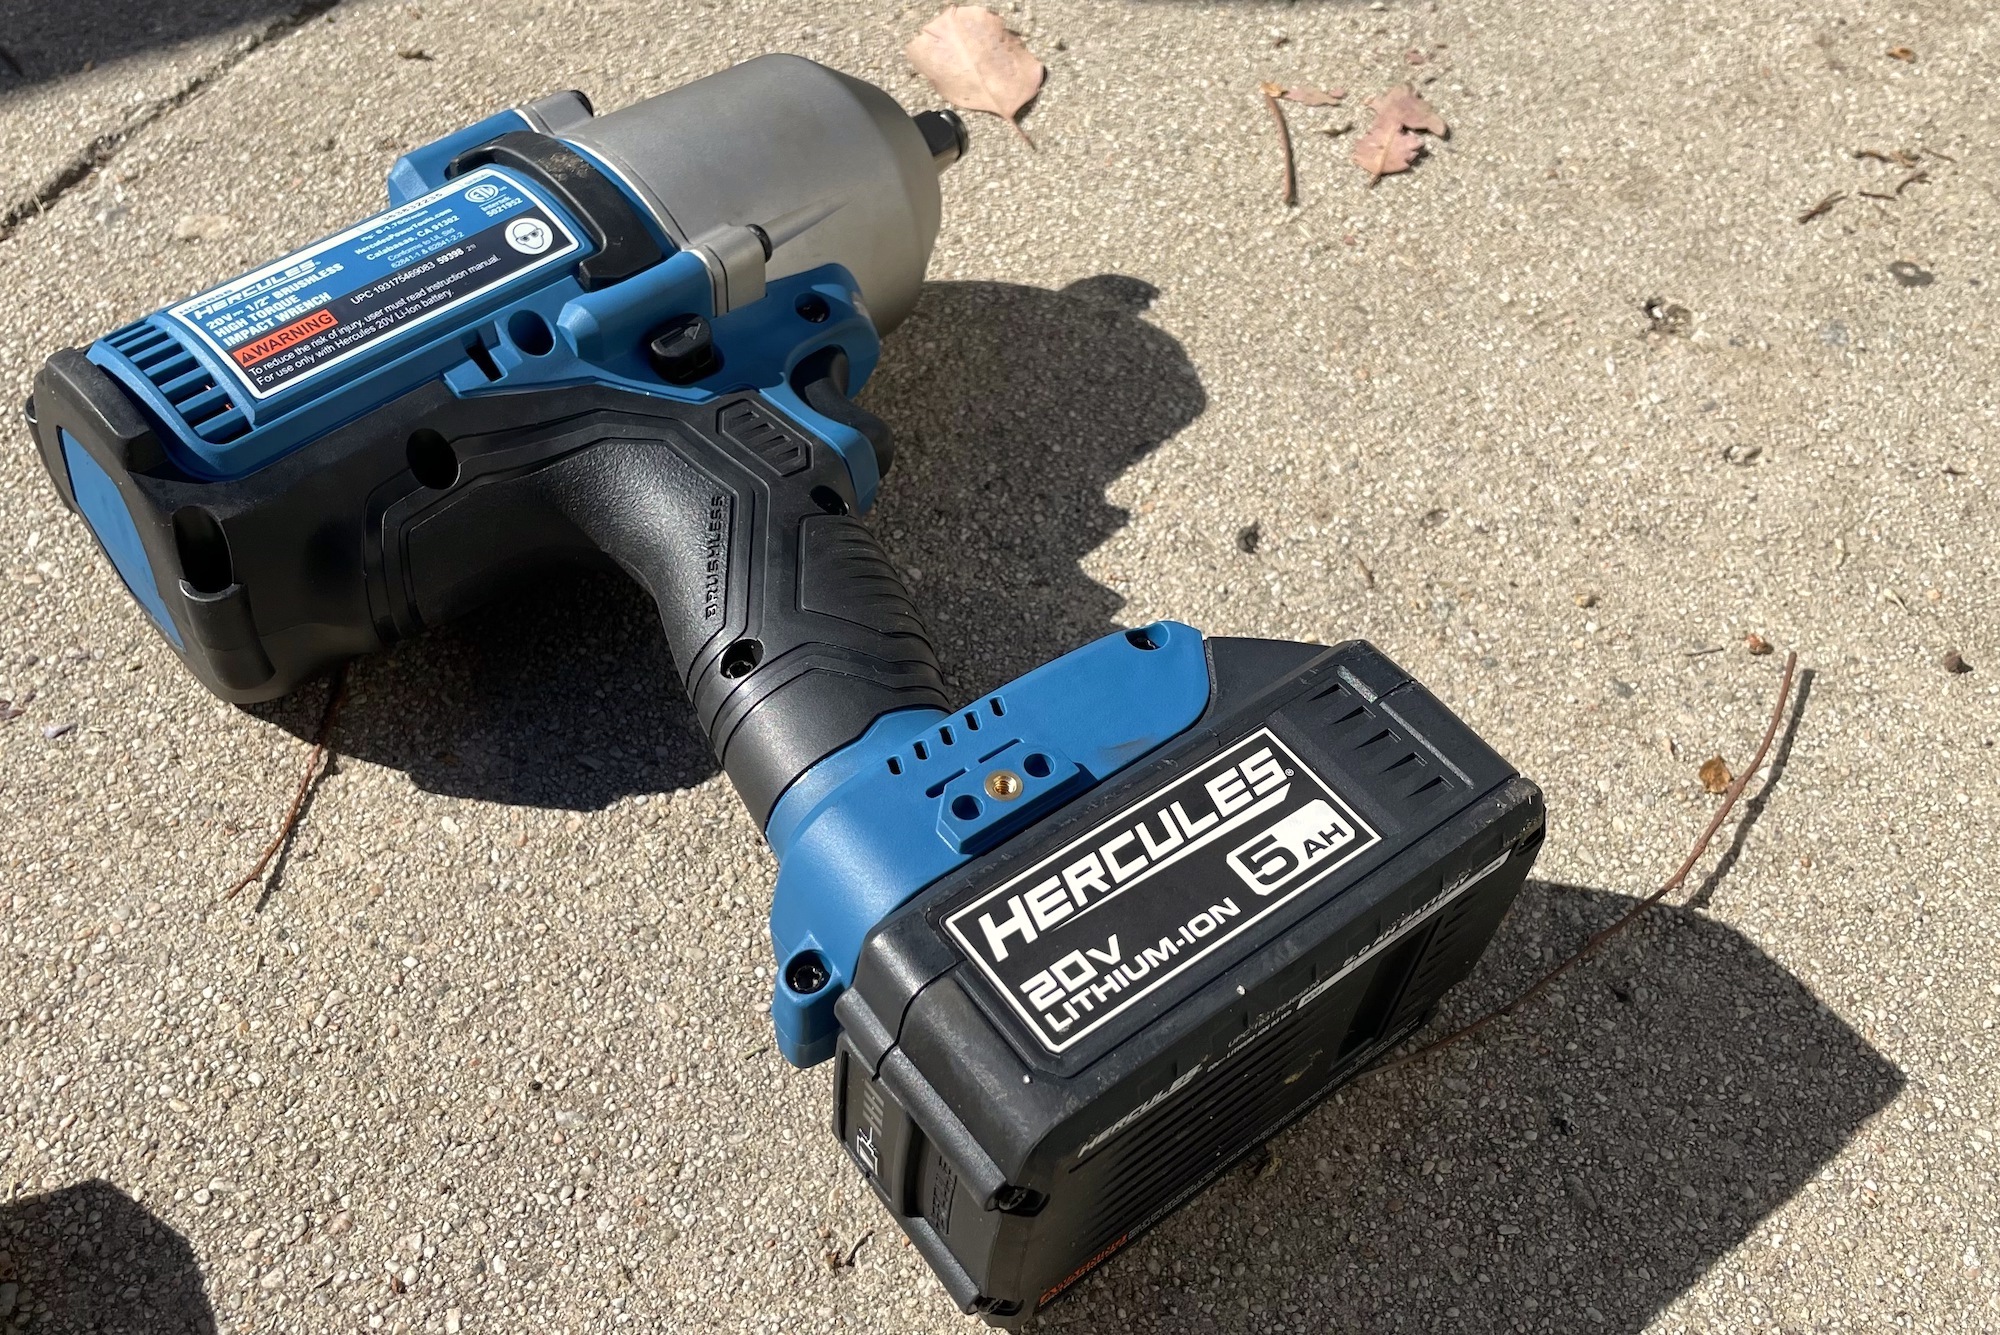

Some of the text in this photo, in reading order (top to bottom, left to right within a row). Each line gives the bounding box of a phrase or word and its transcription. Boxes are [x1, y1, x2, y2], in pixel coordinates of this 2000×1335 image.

[355, 208, 453, 255] HerculesPowerTools.com
[486, 198, 523, 217] 5021952
[366, 215, 460, 261] Calabasas, CA 91302
[387, 228, 455, 262] Conforms to UL Std
[390, 231, 465, 269] 62841-1 & 62841-2-2
[272, 263, 345, 299] BRUSHLESS
[350, 289, 374, 305] UPC
[373, 261, 436, 296] 193175469083
[436, 247, 465, 265] 59398
[213, 294, 301, 338] HIGH TORQUE
[222, 291, 333, 347] IMPACT WRENCH
[249, 254, 502, 377] To reduce the risk of injury, user must read instruction manual.
[250, 313, 333, 357] WARNING
[256, 289, 455, 386] For use only with Hercules 20V Li-Ion battery.
[705, 495, 726, 621] BRUSHLESS
[1235, 822, 1348, 886] 5 AH
[1372, 925, 1397, 947] AH
[1400, 872, 1470, 927] BATTERY
[1019, 933, 1122, 1012] 20V
[1044, 897, 1242, 1033] LITHIUM-ION
